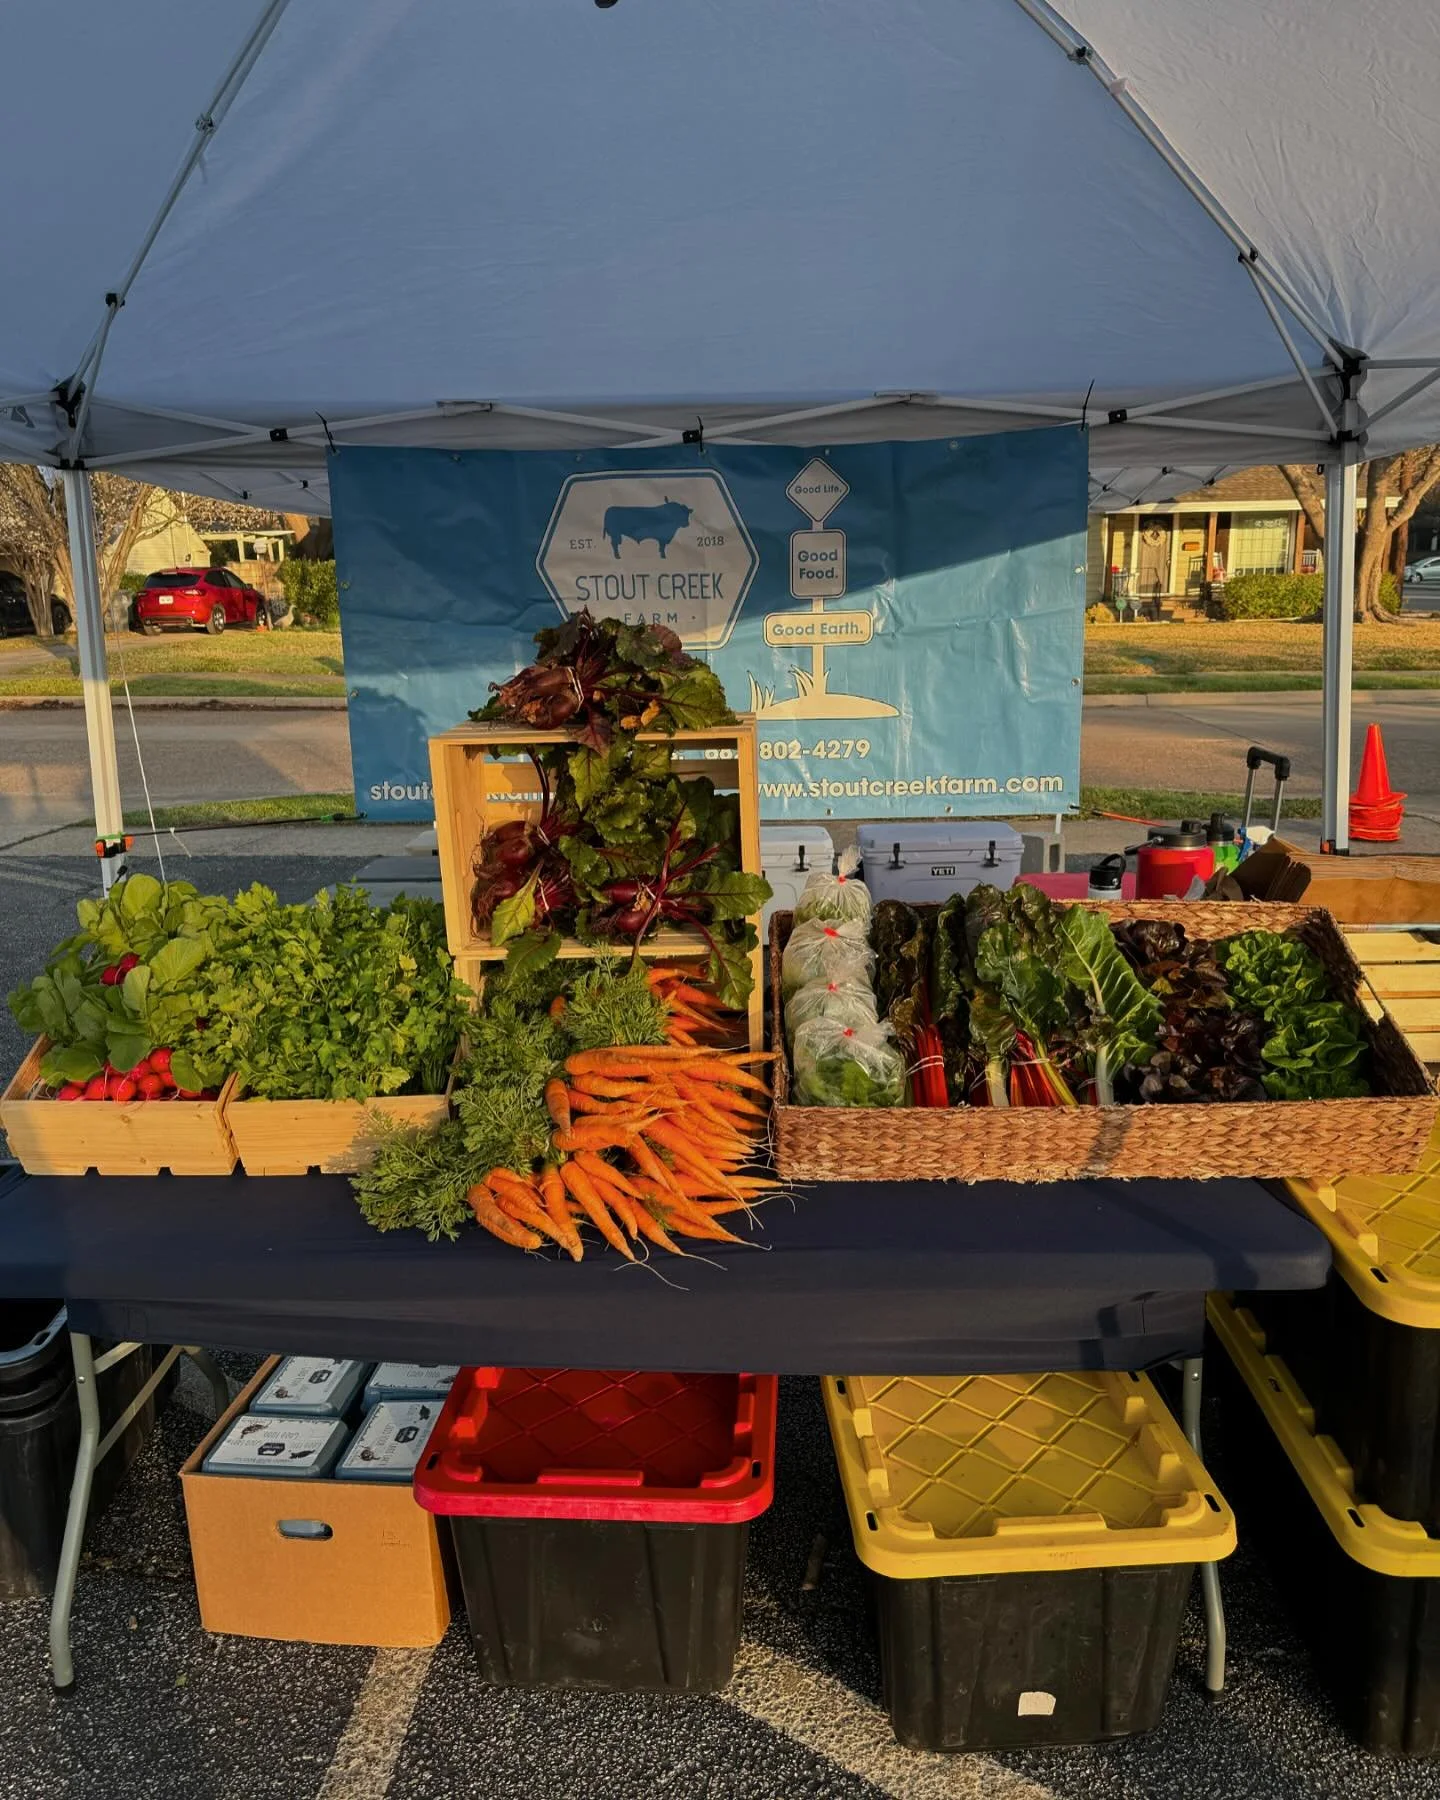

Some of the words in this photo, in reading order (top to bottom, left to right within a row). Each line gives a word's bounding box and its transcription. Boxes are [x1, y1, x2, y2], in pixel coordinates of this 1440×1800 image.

[794, 484, 821, 495] Good
[823, 483, 842, 494] Life.
[569, 538, 597, 550] EST.
[696, 536, 725, 547] 2018
[797, 549, 838, 562] Good
[799, 567, 839, 580] Food.
[575, 574, 650, 601] STOUT
[657, 572, 724, 600] CREEK
[624, 611, 678, 625] FARM
[772, 622, 815, 637] Good
[820, 621, 864, 635] Earth.
[932, 866, 955, 876] YETI
